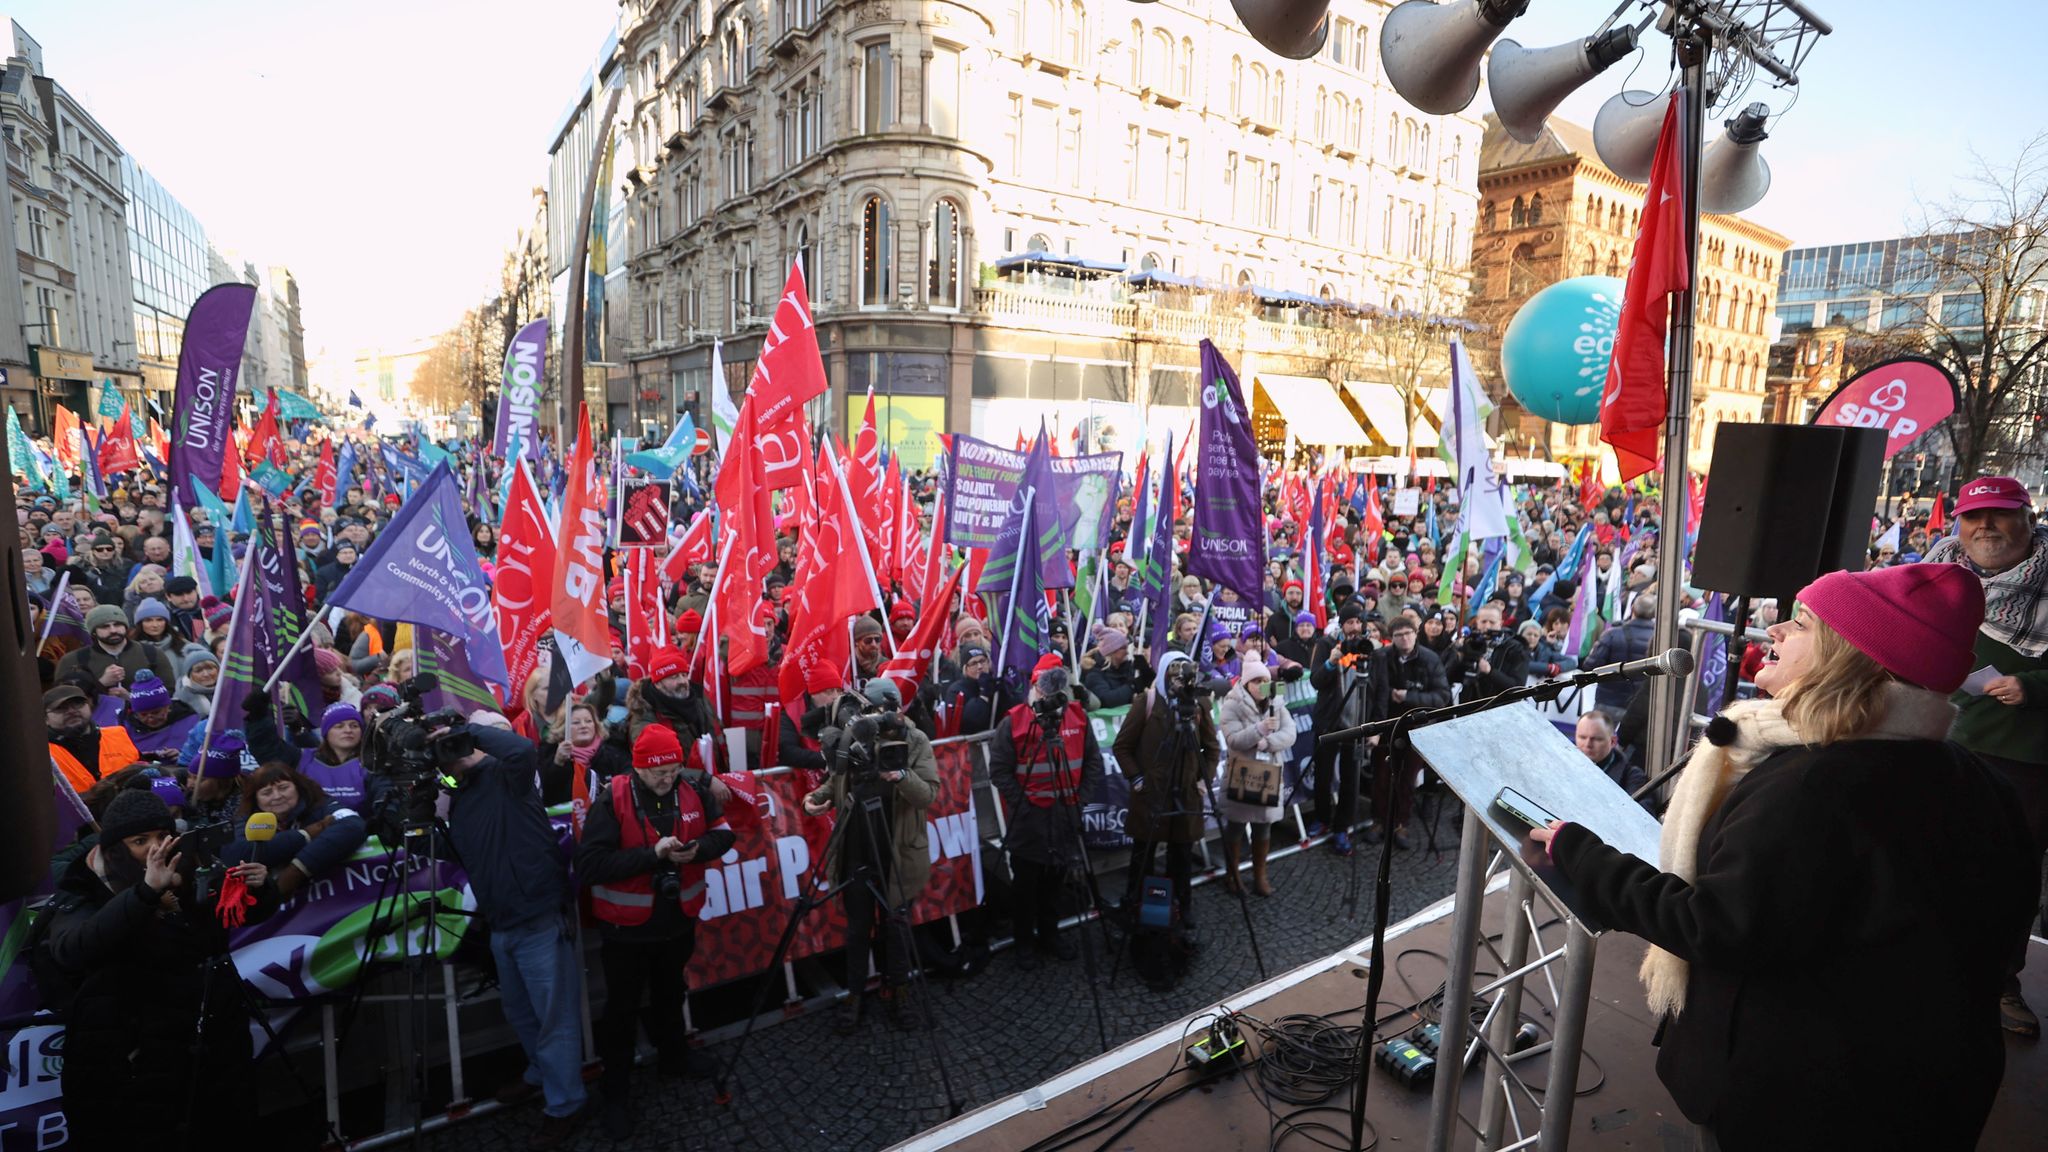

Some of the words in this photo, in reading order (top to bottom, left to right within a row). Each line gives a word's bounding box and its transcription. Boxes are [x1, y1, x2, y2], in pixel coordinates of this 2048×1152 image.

[186, 367, 218, 449] UNISON
[1835, 402, 1918, 439] SDLP
[1969, 485, 2001, 497] UCU
[1201, 537, 1248, 552] UNISON
[387, 561, 445, 602] Community
[408, 557, 440, 581] North
[439, 575, 448, 585] &
[1214, 607, 1248, 620] FFICIAL
[647, 752, 678, 766] nipsa
[698, 847, 768, 922] air
[926, 810, 973, 864] ow
